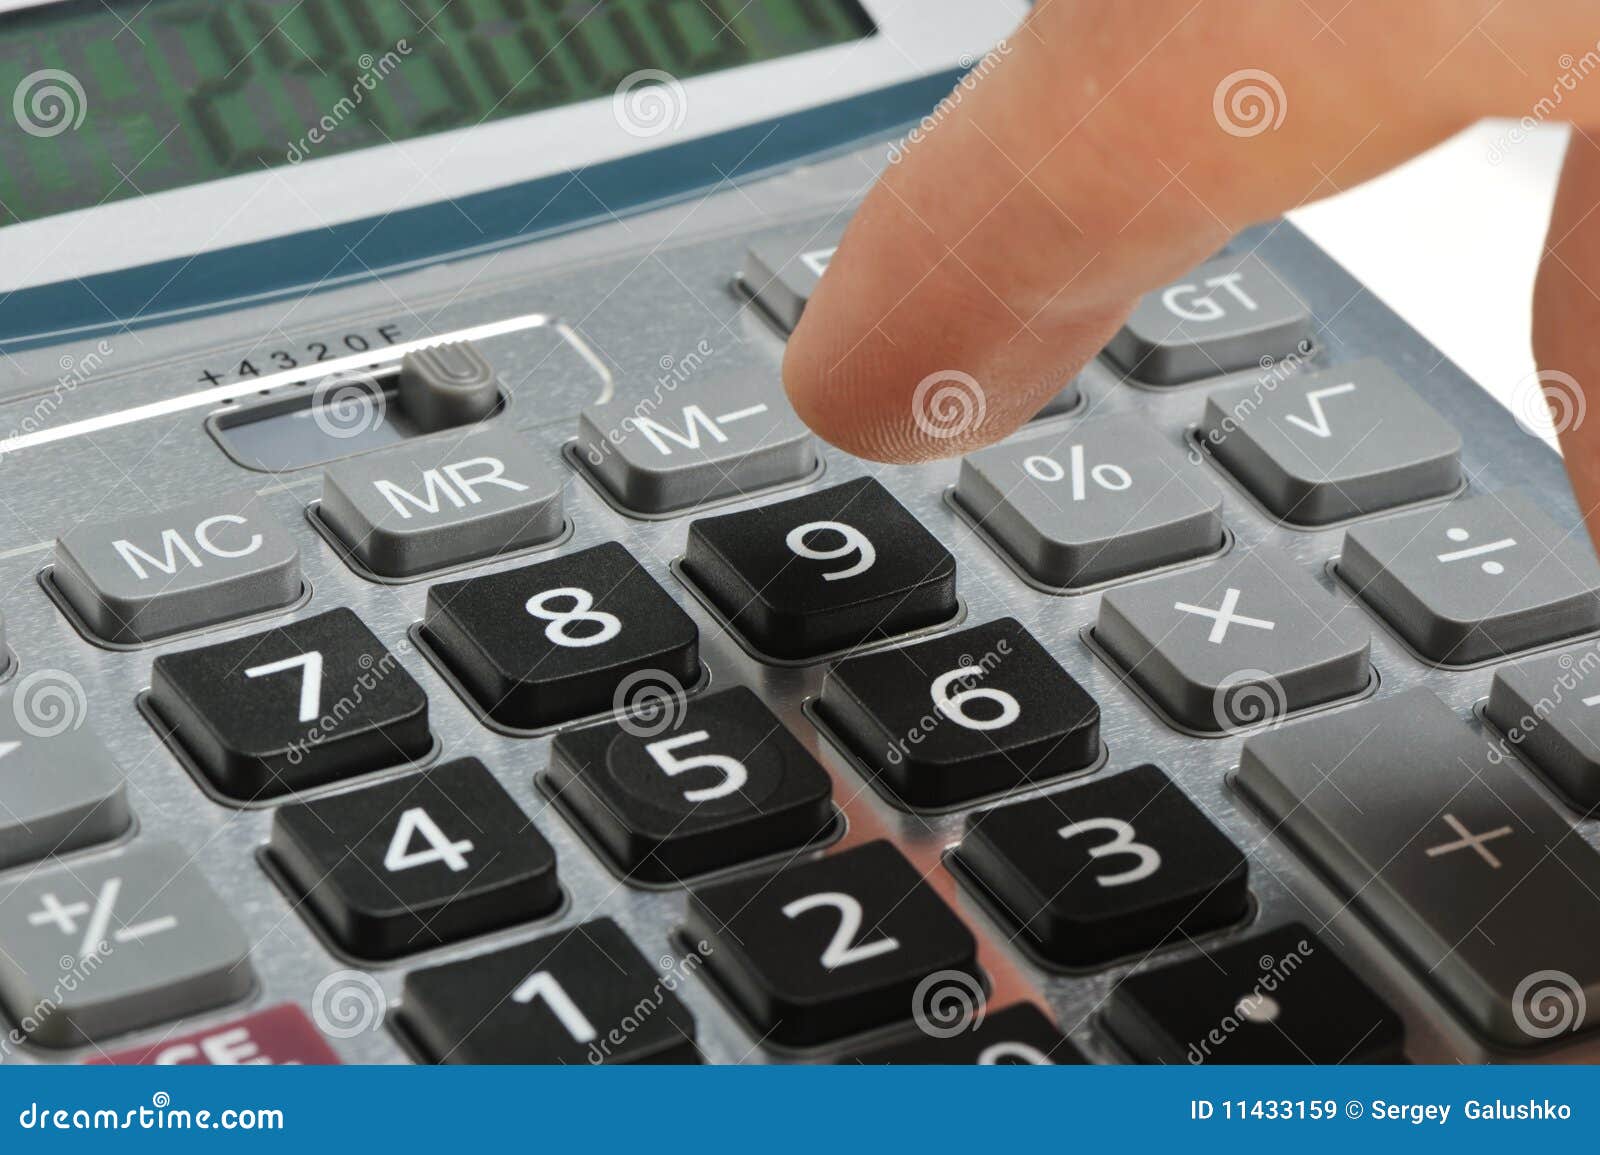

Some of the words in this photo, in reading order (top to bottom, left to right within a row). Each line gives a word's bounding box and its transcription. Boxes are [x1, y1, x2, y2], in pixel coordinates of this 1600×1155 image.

[1162, 272, 1258, 322] GT
[373, 456, 529, 520] MR
[1023, 445, 1133, 501] %
[111, 514, 263, 580] MC
[785, 520, 877, 582] 9
[524, 586, 623, 649] 8
[243, 651, 324, 723] 7
[929, 665, 1021, 731] 6
[644, 730, 748, 803] 5
[383, 807, 475, 872] 4
[1057, 817, 1162, 887] 3
[781, 891, 900, 969] 2
[512, 970, 597, 1043] 1
